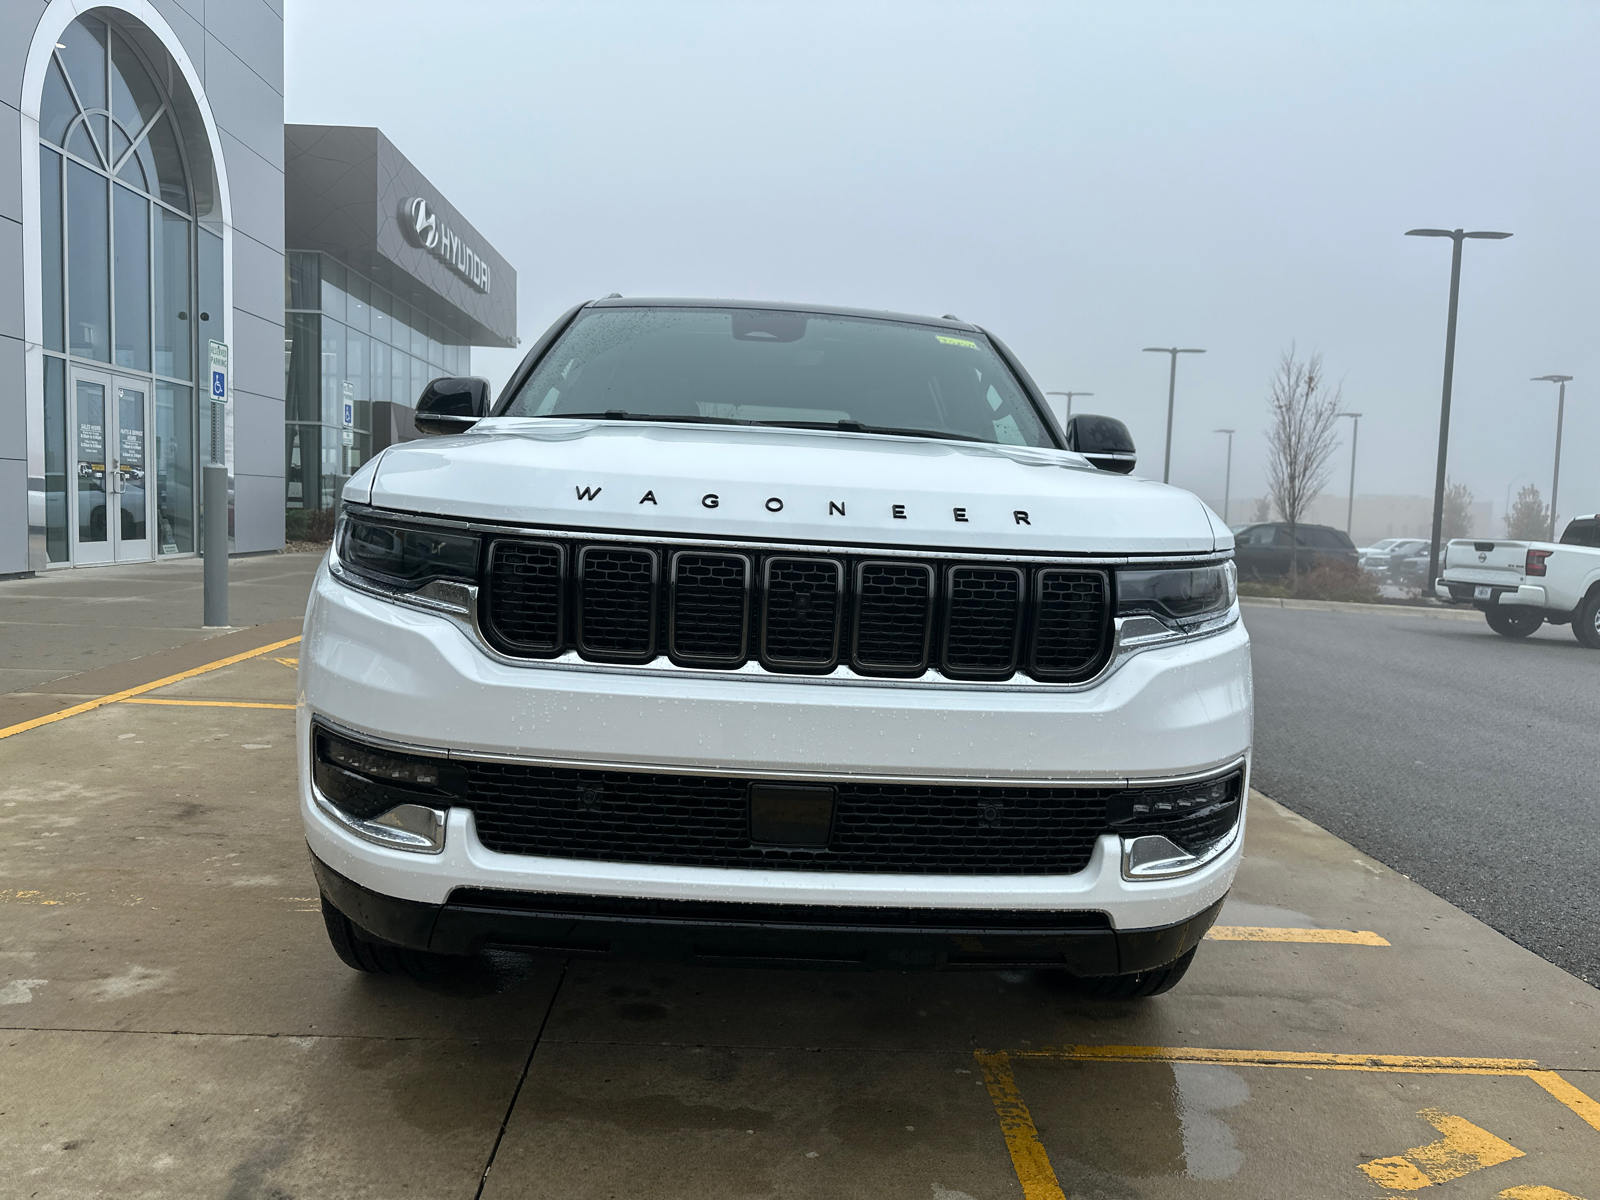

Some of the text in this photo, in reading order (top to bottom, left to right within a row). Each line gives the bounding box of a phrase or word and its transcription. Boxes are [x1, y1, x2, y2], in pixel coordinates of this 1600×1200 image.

[441, 222, 490, 294] HYUNDAI
[210, 356, 227, 368] PARKING
[575, 485, 1032, 526] WAGONEER
